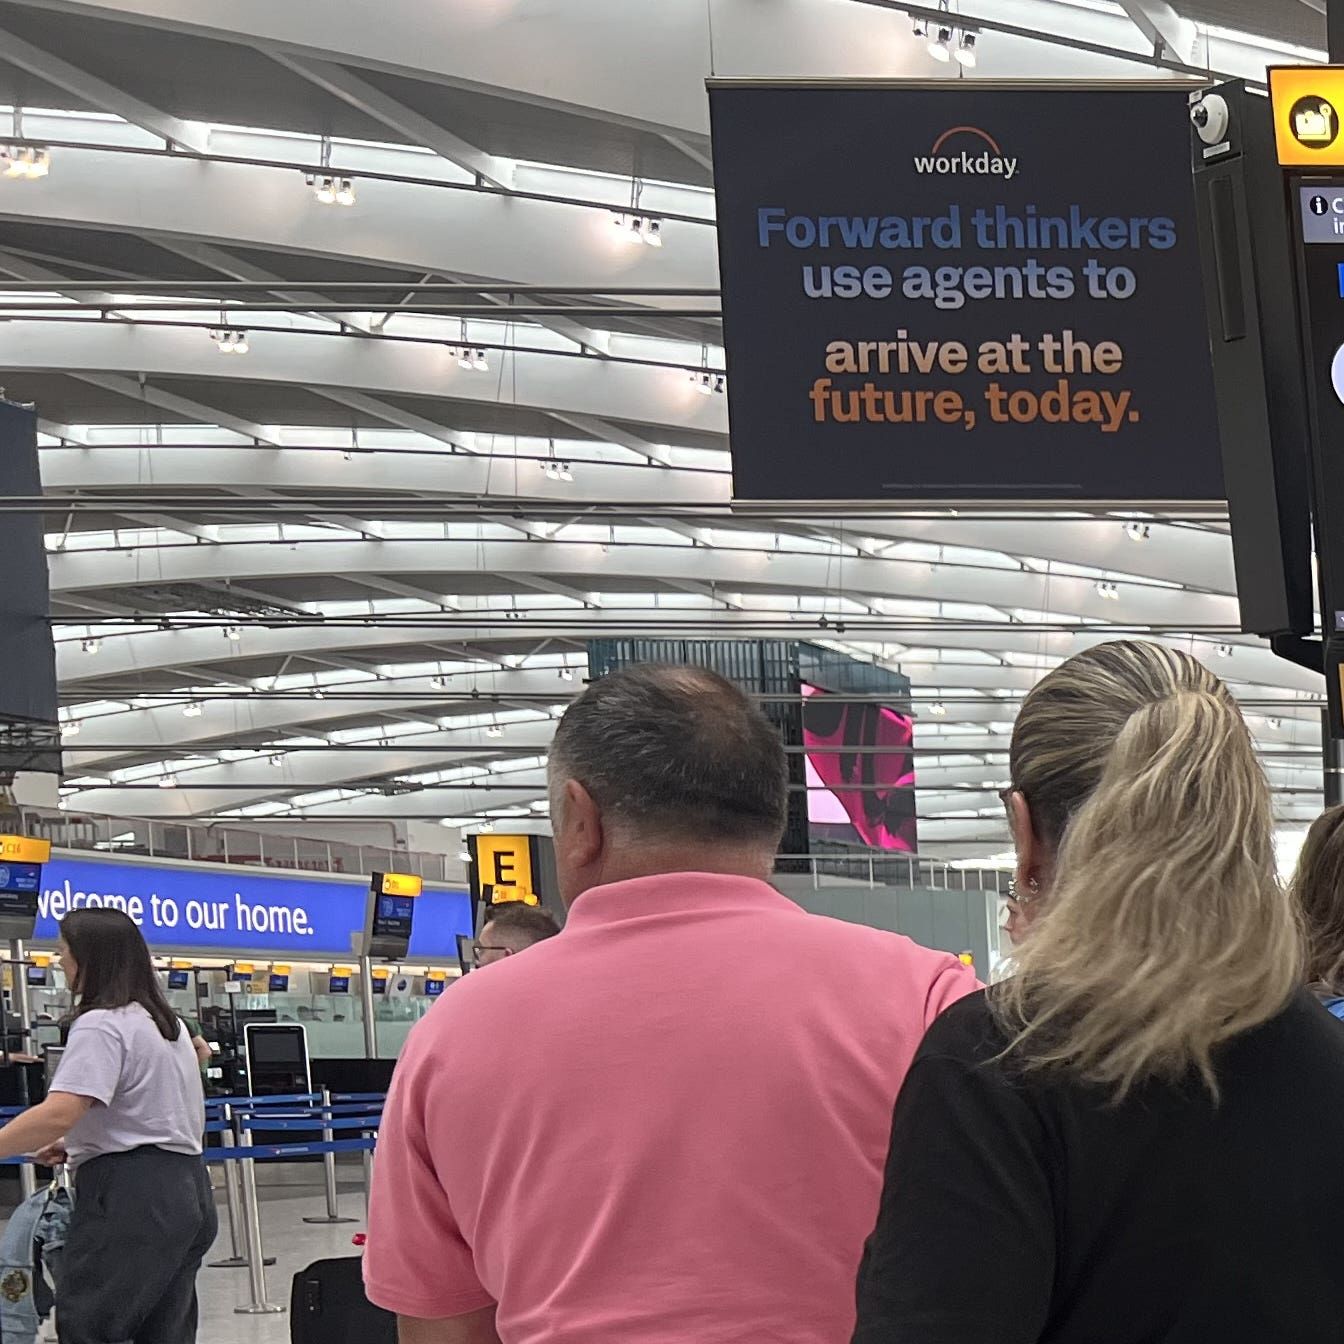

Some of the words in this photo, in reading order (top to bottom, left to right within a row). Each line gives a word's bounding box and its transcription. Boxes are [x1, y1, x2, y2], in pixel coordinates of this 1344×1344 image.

[914, 152, 1017, 179] workday
[757, 205, 959, 249] Forward
[972, 205, 1177, 249] thinkers
[803, 265, 892, 299] use
[902, 258, 1074, 309] agents
[1083, 258, 1136, 299] to
[825, 329, 968, 374] arrive
[977, 333, 1030, 374] at
[1038, 330, 1123, 374] the
[809, 379, 976, 430] future,
[985, 379, 1140, 432] today.
[493, 851, 516, 886] E
[150, 894, 178, 927] to
[186, 901, 229, 929] our
[235, 893, 314, 935] home.
